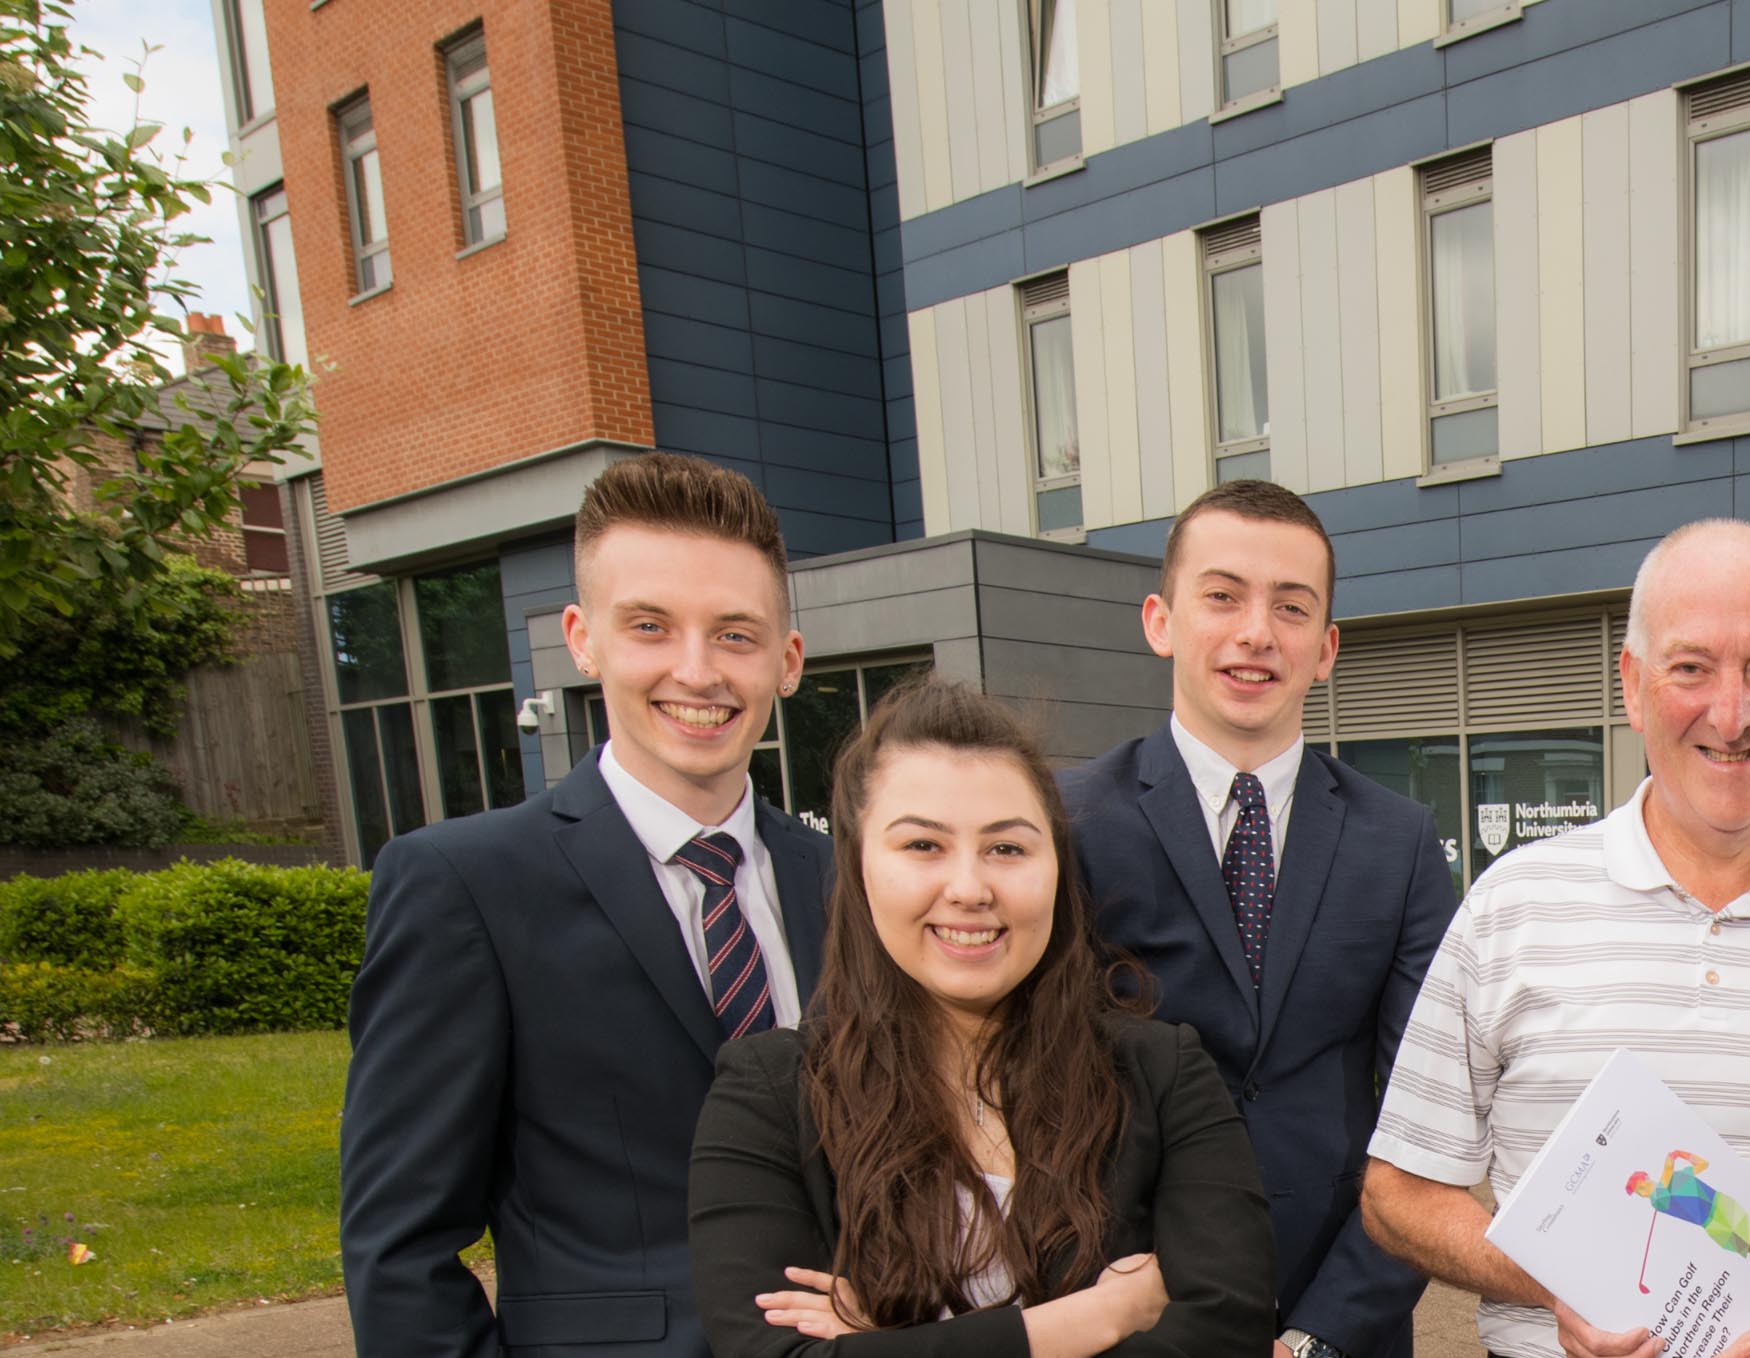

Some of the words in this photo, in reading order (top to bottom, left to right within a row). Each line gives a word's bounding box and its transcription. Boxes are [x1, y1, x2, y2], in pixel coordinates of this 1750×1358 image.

[799, 810, 829, 834] The
[1515, 800, 1598, 819] Northumbria
[1515, 820, 1580, 838] Universit
[1648, 1314, 1668, 1339] How
[1664, 1289, 1683, 1313] Can
[1679, 1261, 1698, 1288] Golf
[1701, 1270, 1731, 1312] Region
[1662, 1319, 1685, 1353] Clubs
[1680, 1305, 1691, 1318] in
[1687, 1285, 1703, 1305] the
[1711, 1293, 1733, 1323] Their
